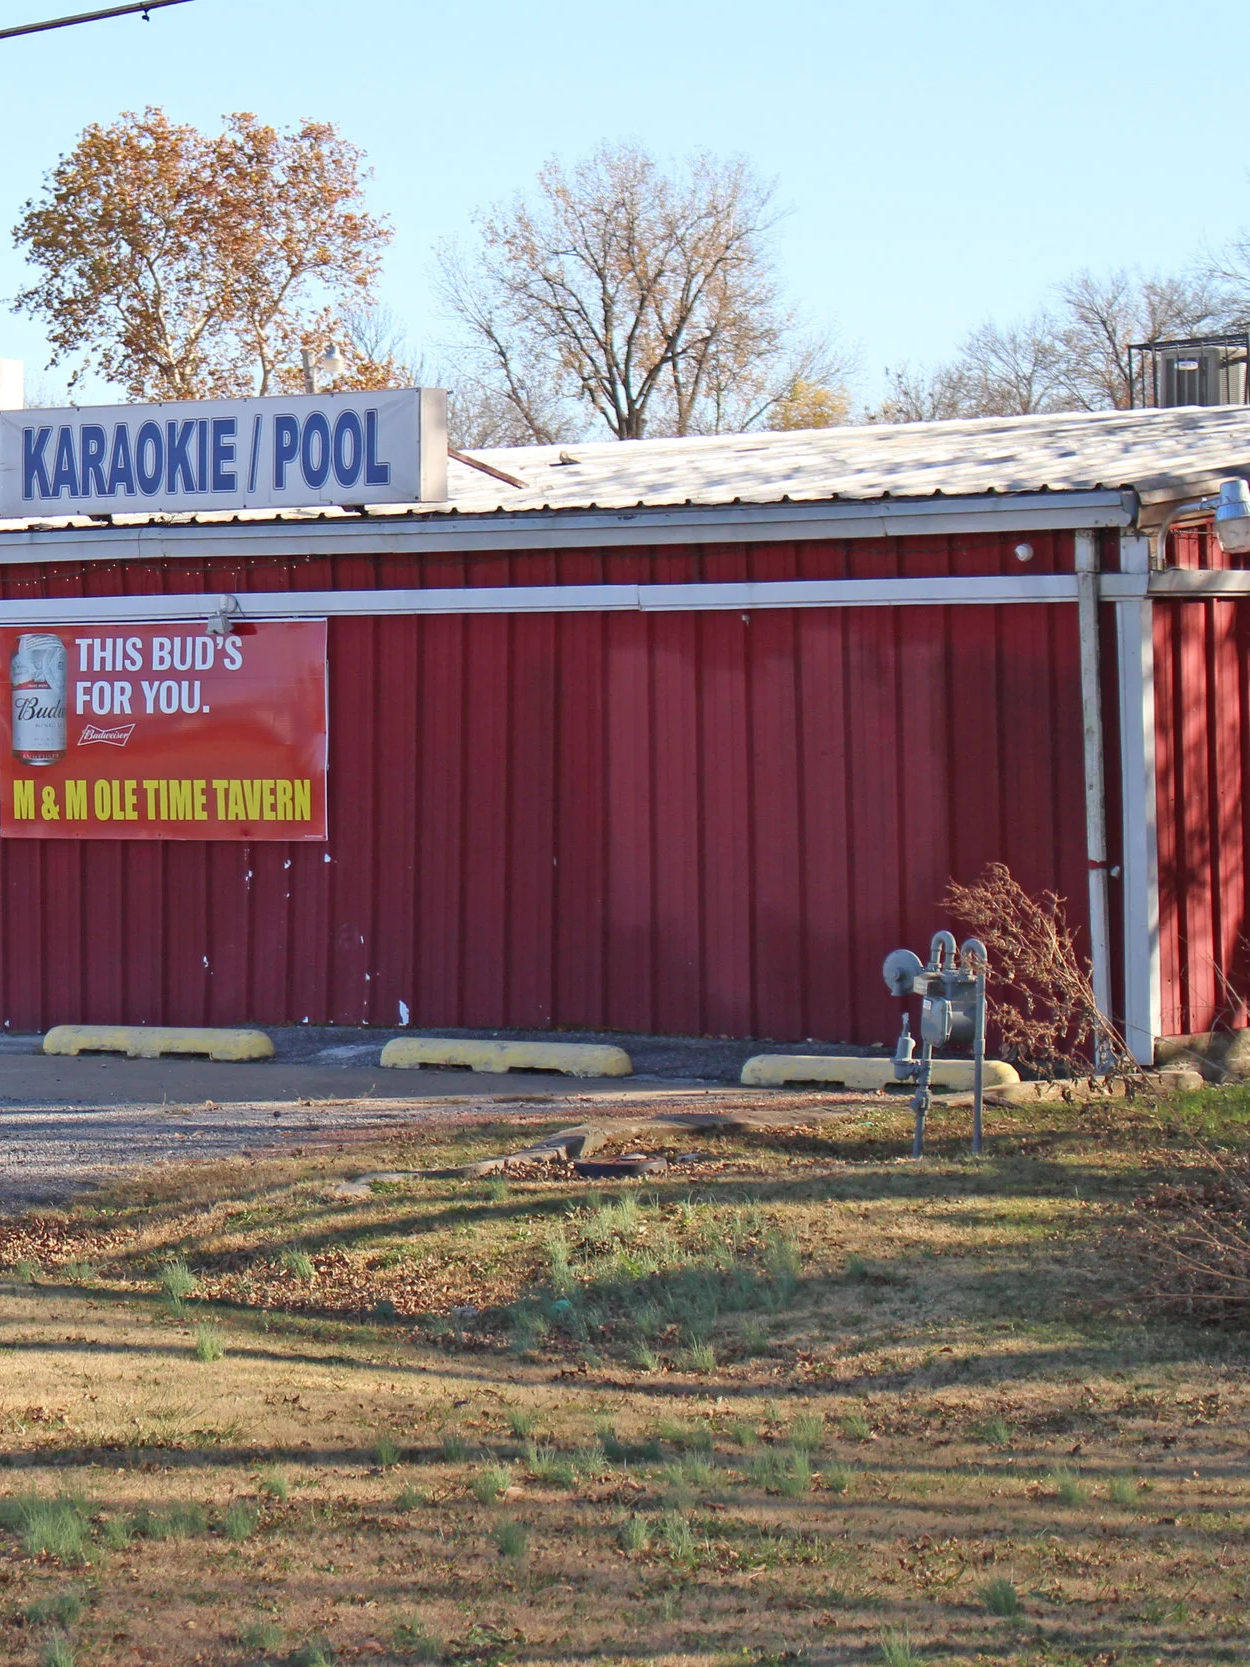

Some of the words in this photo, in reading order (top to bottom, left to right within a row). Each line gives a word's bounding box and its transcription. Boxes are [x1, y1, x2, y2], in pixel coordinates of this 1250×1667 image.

[22, 416, 238, 500] KARAOKIE
[273, 408, 391, 491] POOL
[75, 637, 143, 672] THIS
[152, 636, 243, 671] BUD'S
[75, 681, 132, 715] FOR
[141, 680, 210, 714] YOU.
[82, 729, 130, 740] Budweiser
[13, 779, 35, 820] M
[41, 786, 59, 820] &
[65, 779, 88, 820] M
[94, 779, 138, 821] OLE
[143, 779, 208, 821] TIME
[212, 779, 311, 821] TAVERN
